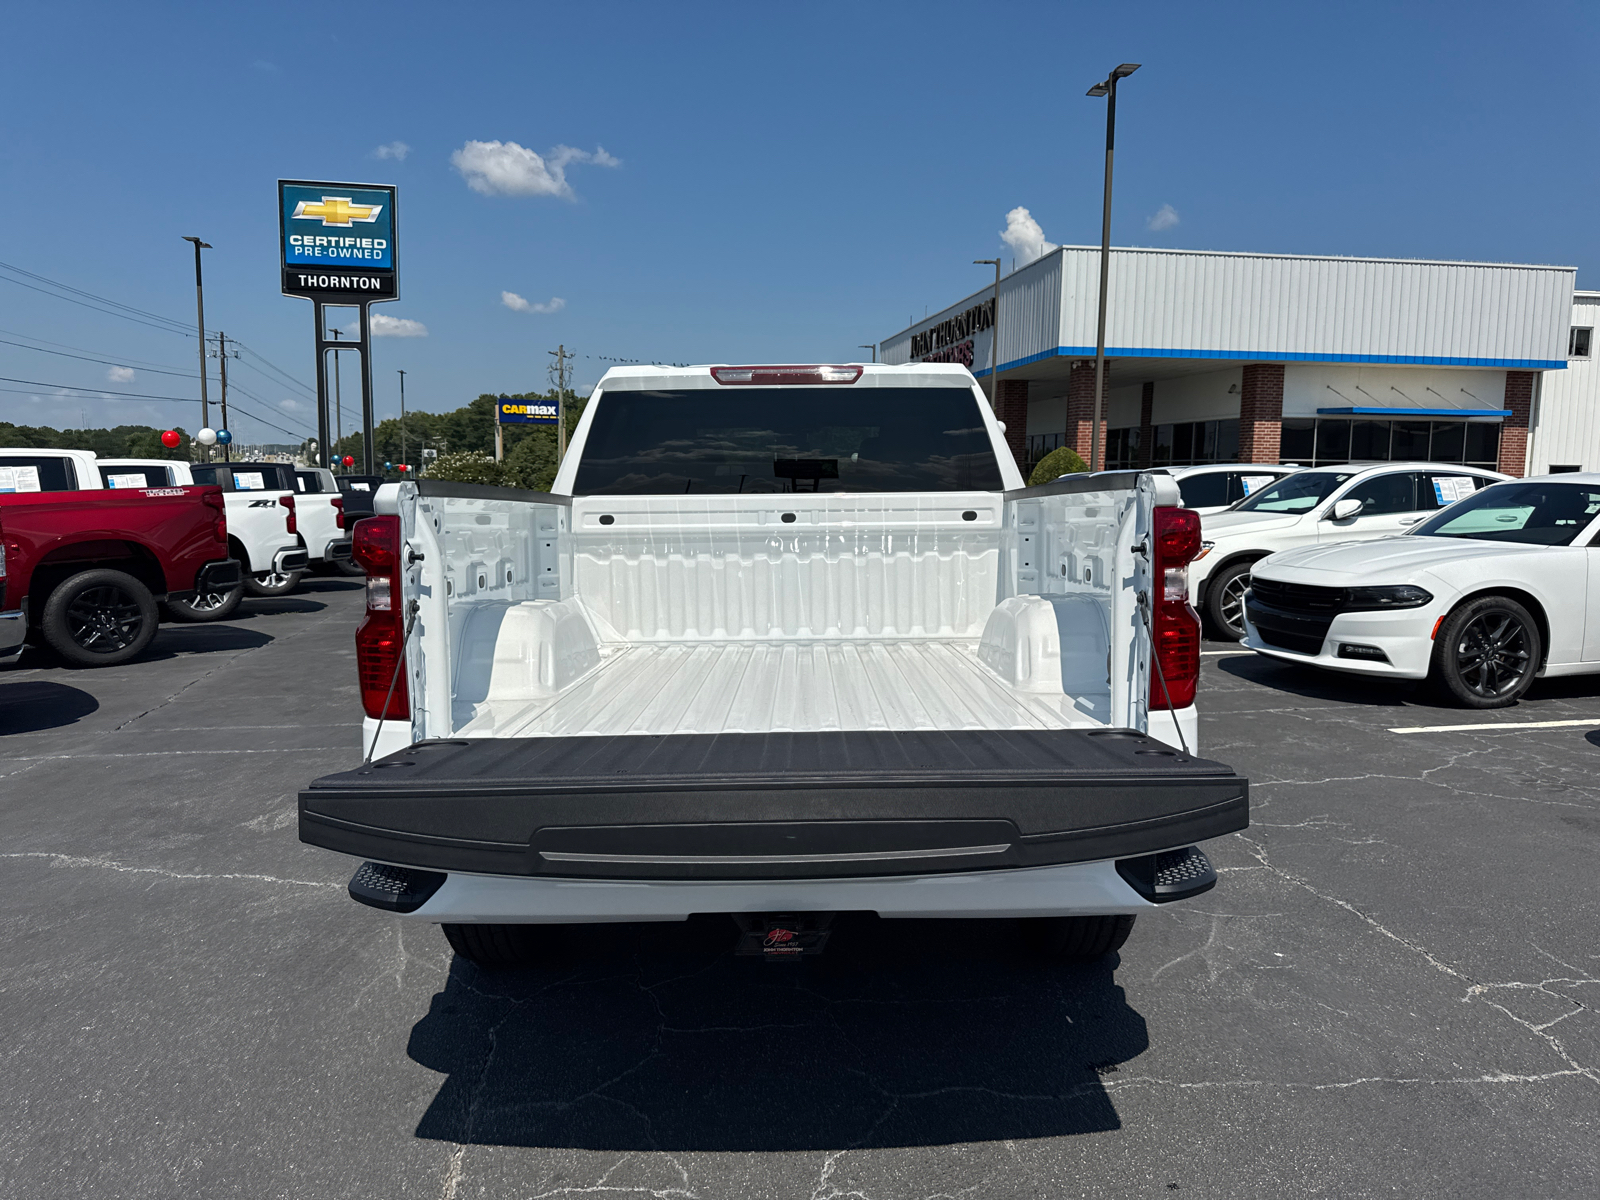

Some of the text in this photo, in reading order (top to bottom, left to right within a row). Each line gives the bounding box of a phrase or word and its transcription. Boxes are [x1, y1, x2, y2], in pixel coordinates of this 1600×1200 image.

[290, 235, 386, 249] CERTIFIED
[295, 246, 382, 259] PRE-OWNED
[298, 275, 380, 290] THORNTON
[910, 297, 996, 359] JOHN THORNTON
[945, 340, 974, 367] CARS
